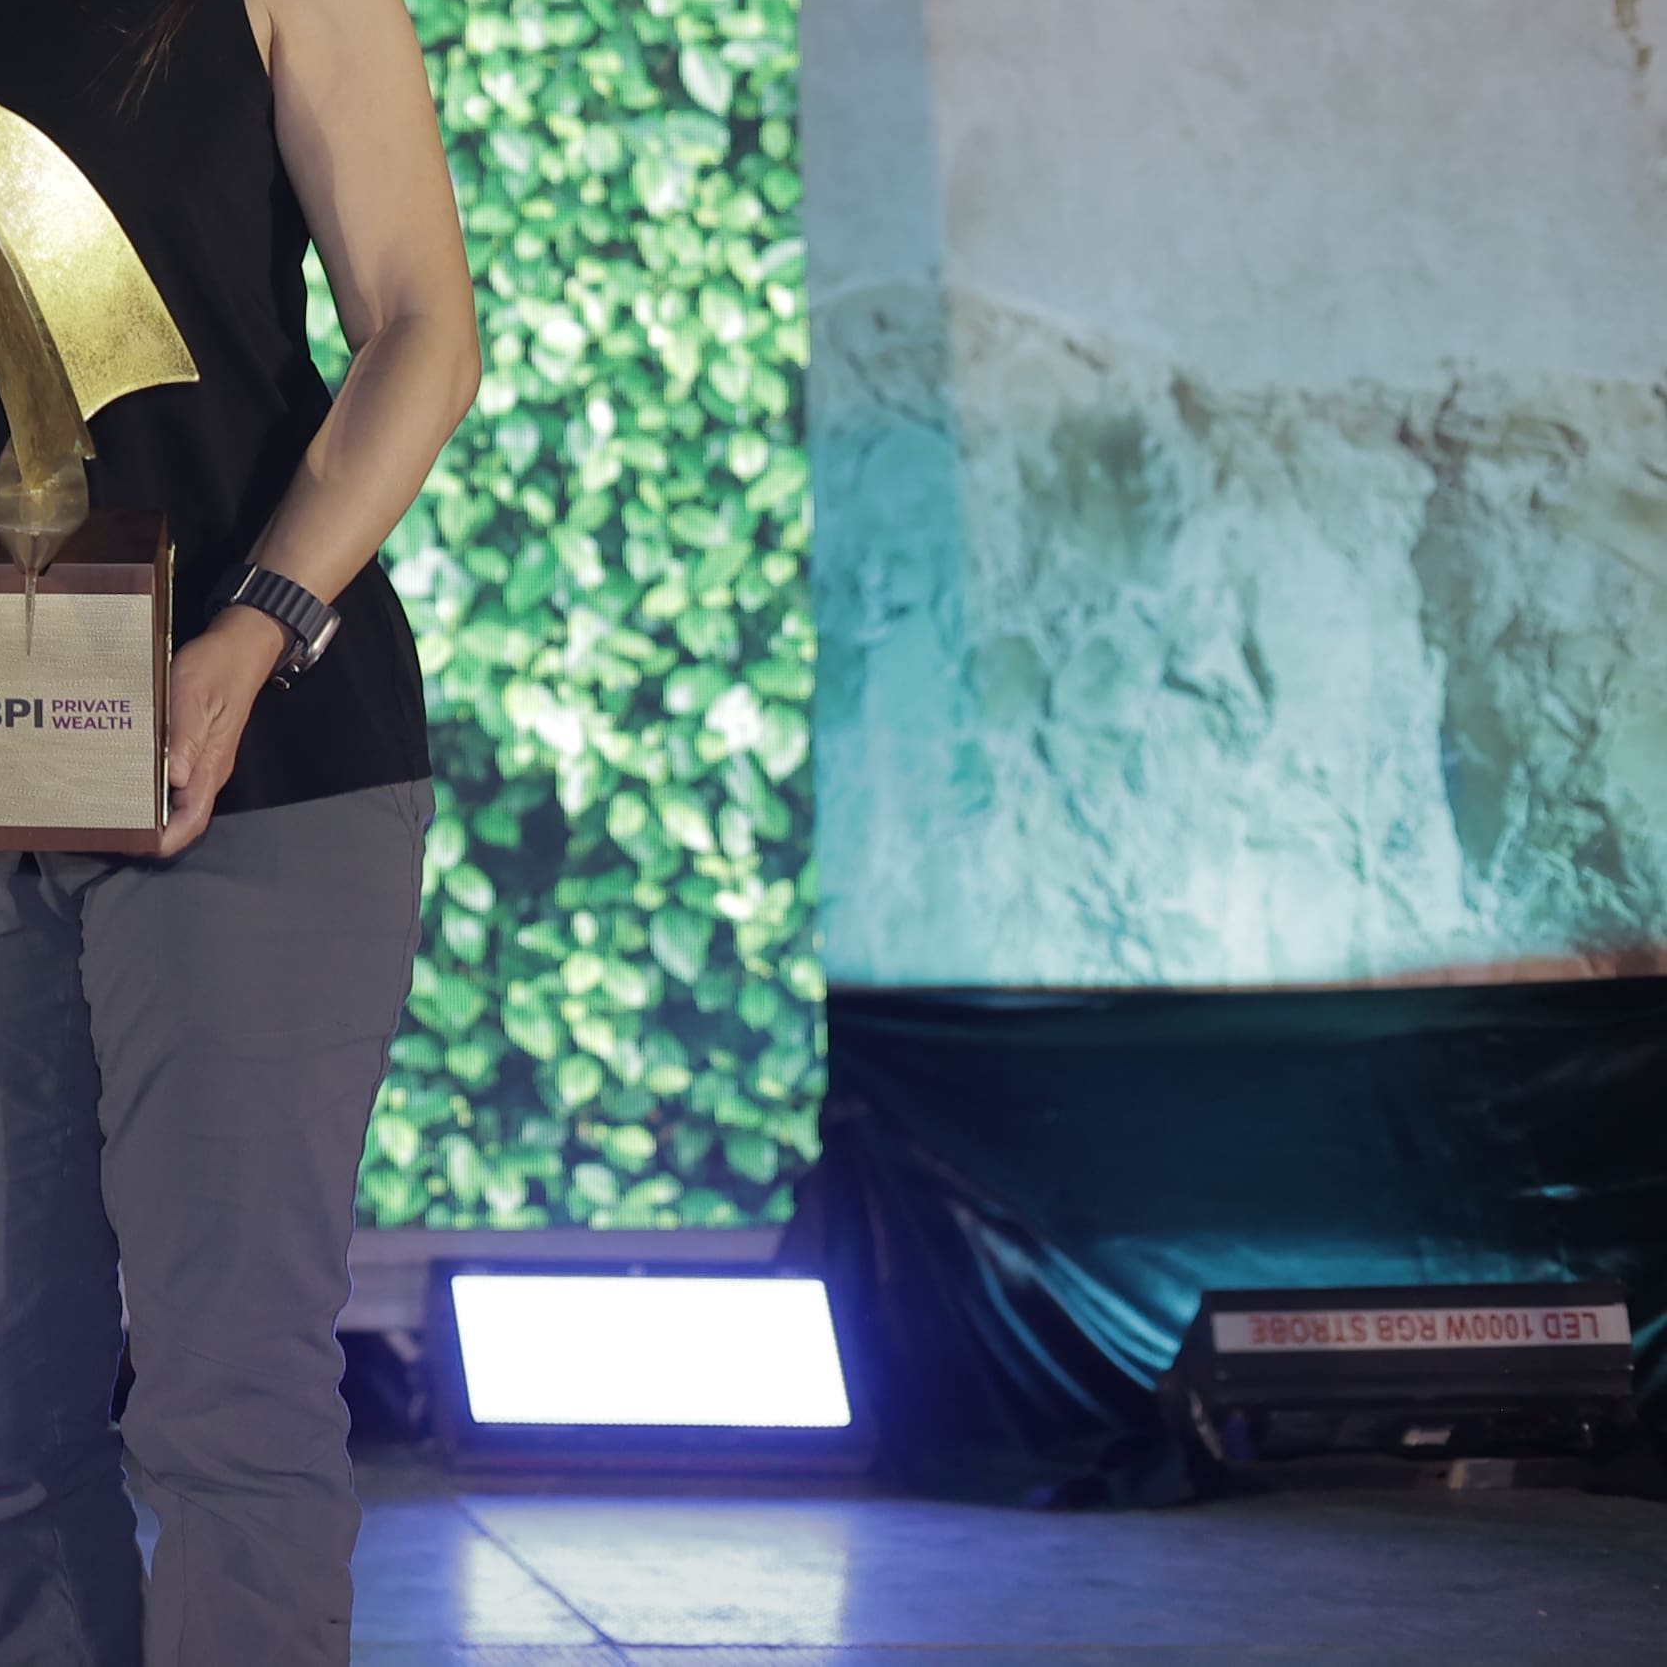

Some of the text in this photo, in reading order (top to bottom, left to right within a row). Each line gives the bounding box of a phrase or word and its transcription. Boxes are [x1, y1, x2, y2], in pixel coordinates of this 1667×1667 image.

[52, 699, 131, 713] PRIVATE
[52, 715, 132, 730] WEALTH
[1249, 1311, 1600, 1345] LED 1000W RGB STROBE
